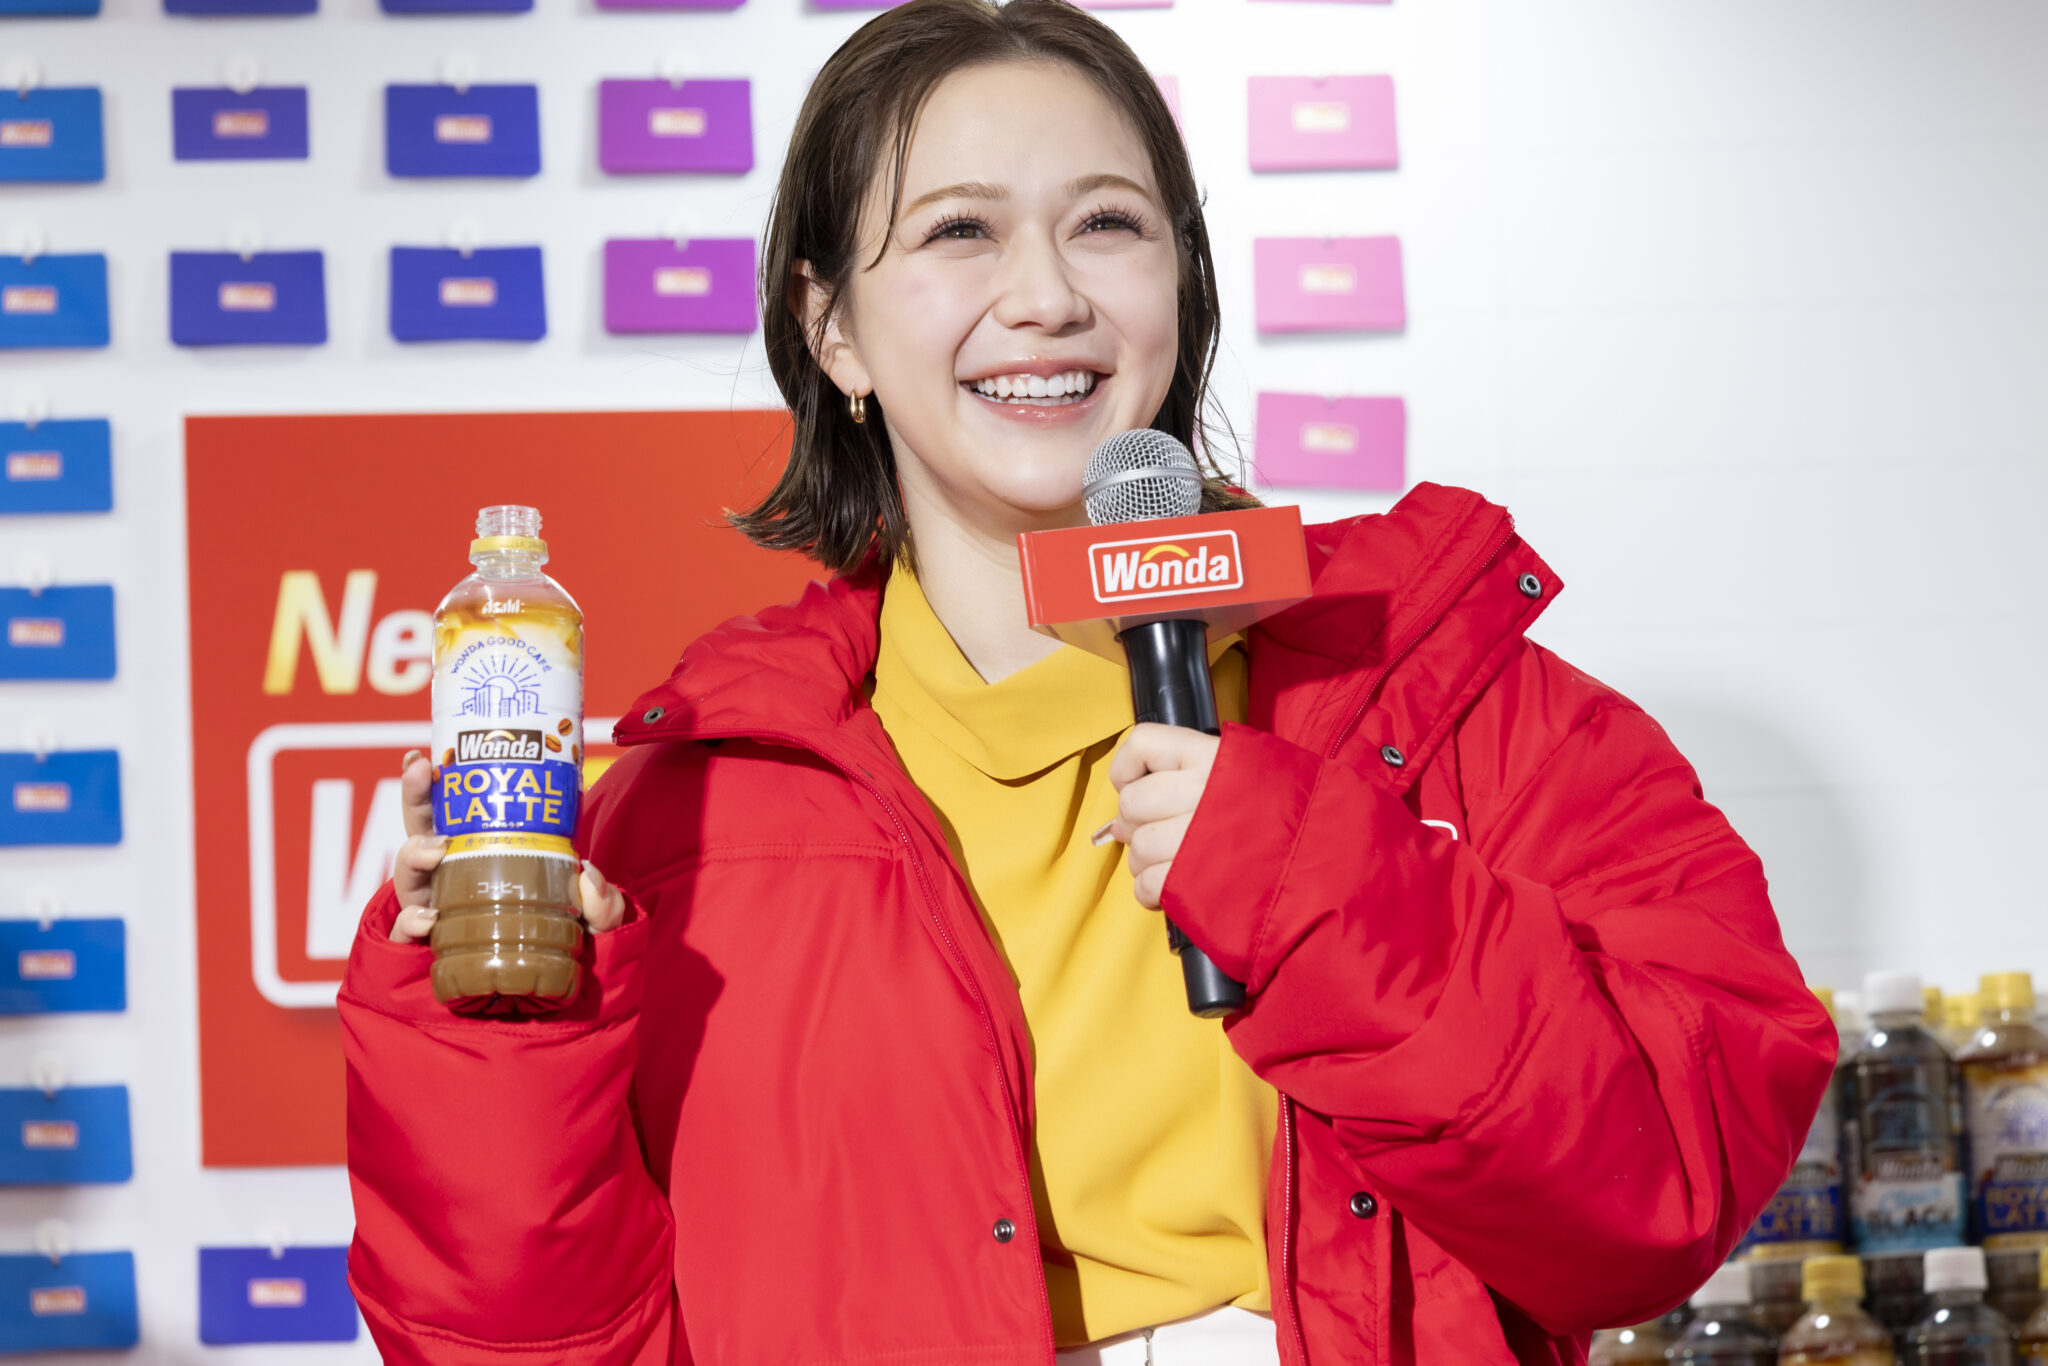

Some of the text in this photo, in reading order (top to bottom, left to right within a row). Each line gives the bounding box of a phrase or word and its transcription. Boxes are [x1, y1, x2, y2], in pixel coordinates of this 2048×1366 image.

[1103, 545, 1229, 592] Wonda
[482, 599, 525, 614] Asahi
[450, 640, 485, 674] WONDA
[487, 635, 526, 649] GOOD
[461, 733, 540, 761] Wonda
[443, 767, 563, 798] ROYAL
[444, 795, 563, 826] LATTE
